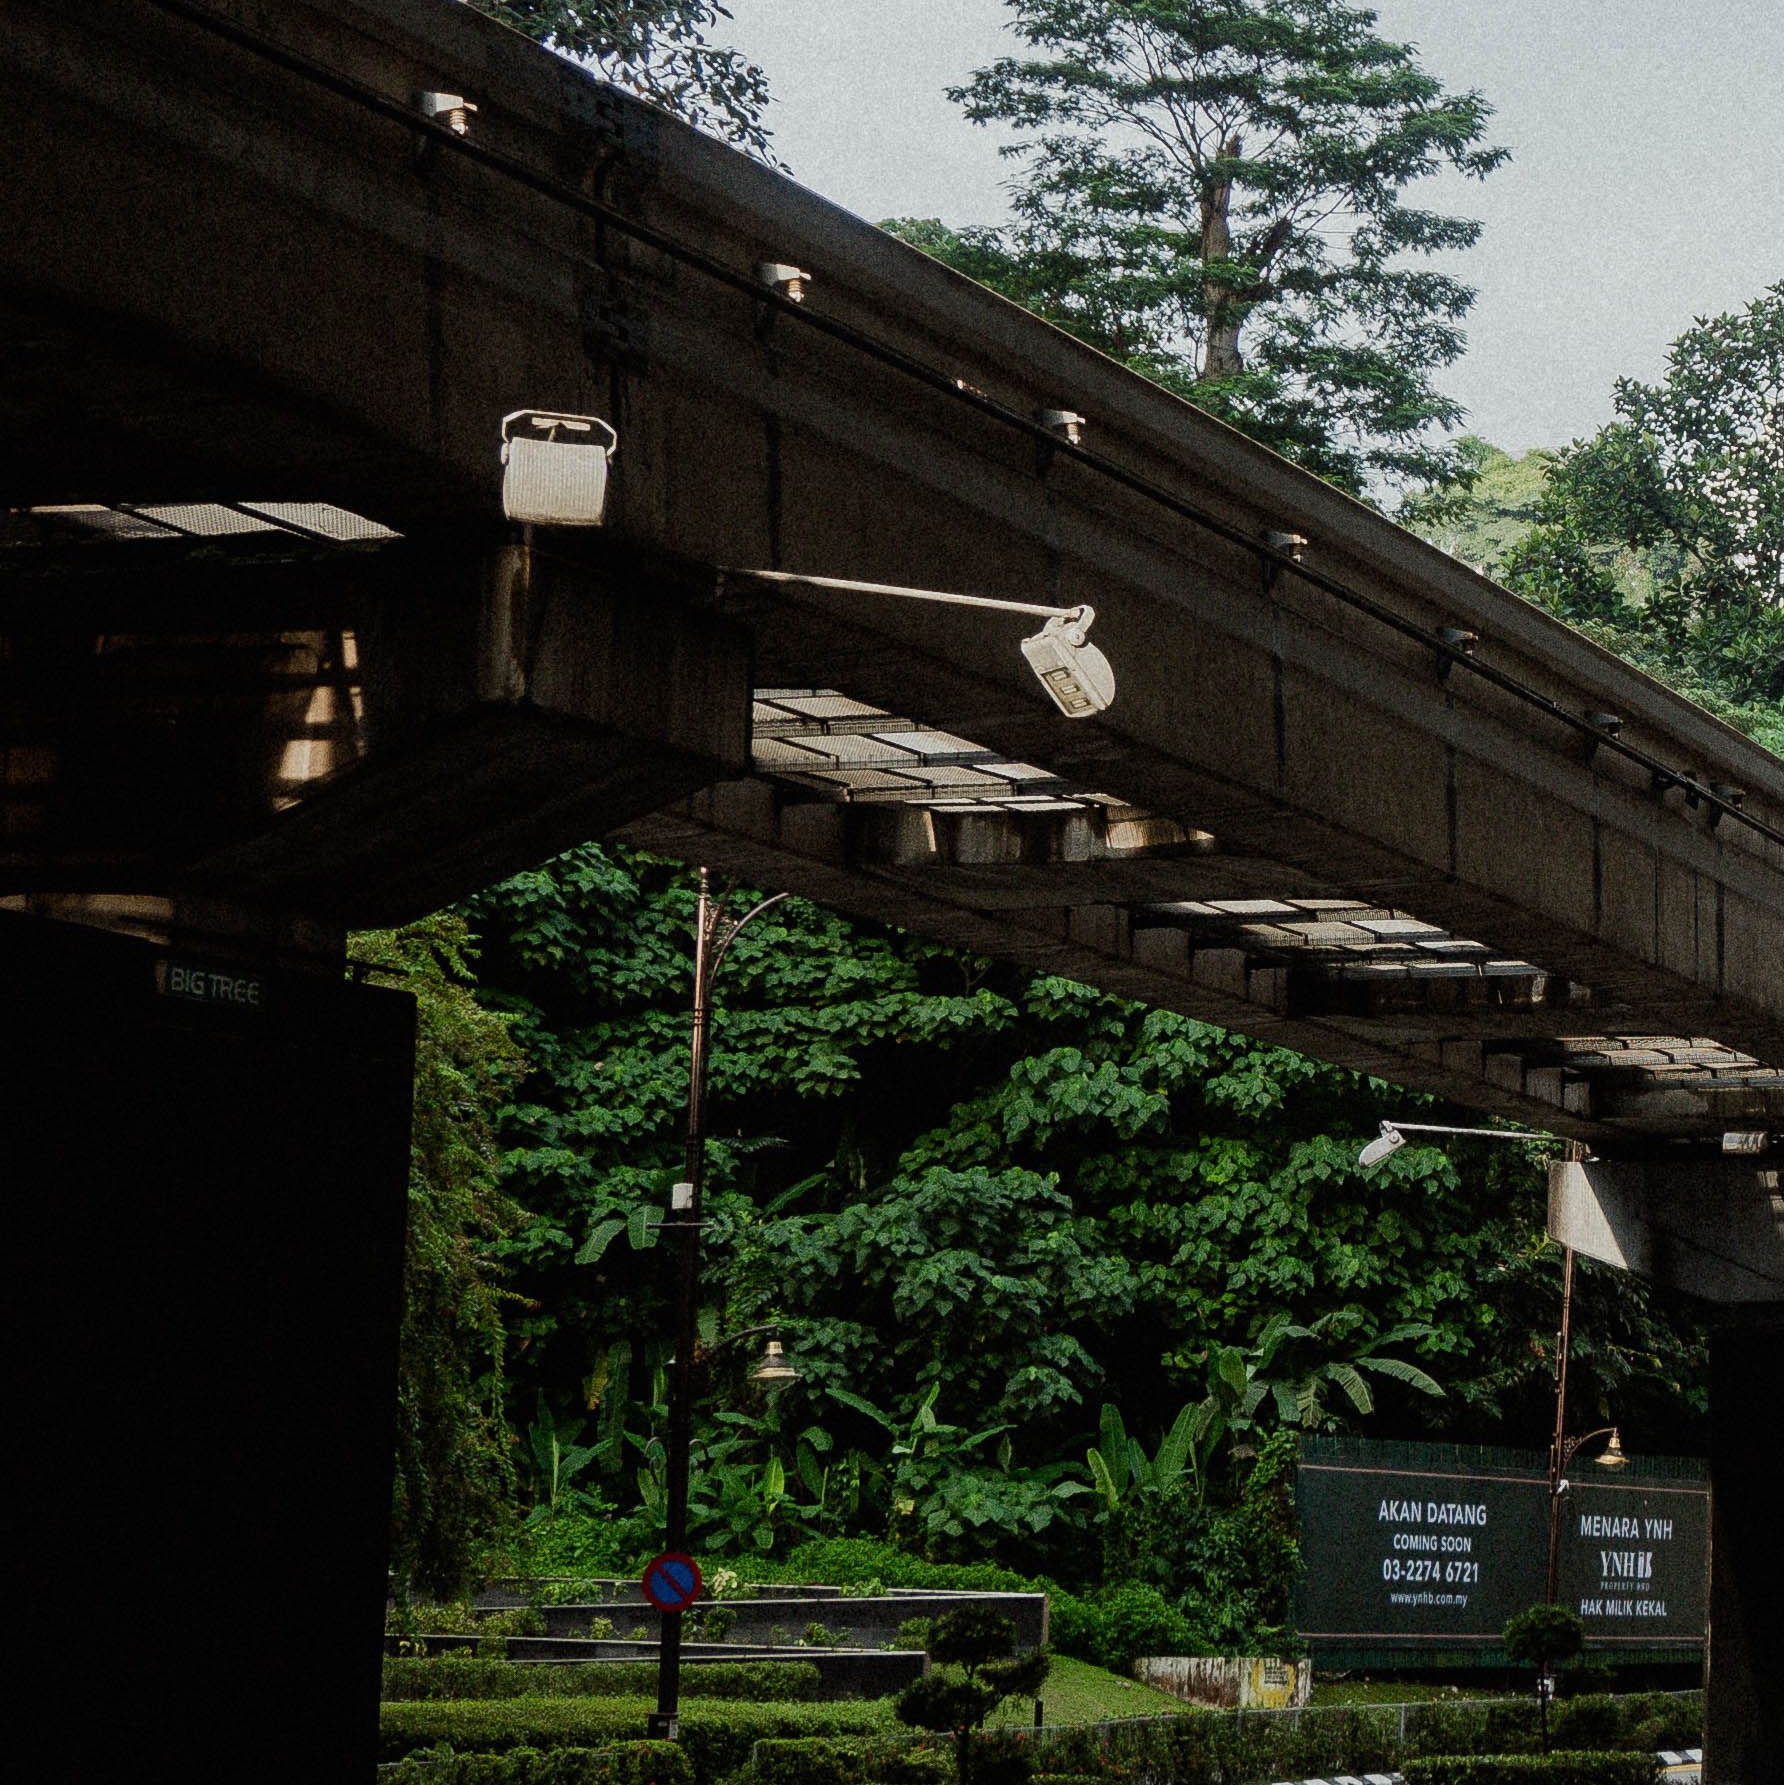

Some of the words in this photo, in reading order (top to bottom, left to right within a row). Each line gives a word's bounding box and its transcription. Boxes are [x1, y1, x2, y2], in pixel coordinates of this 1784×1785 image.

[170, 968, 206, 995] BIG
[208, 973, 261, 1006] TREE
[1378, 1499, 1422, 1523] AKAN
[1427, 1502, 1487, 1526] DATANG
[1580, 1514, 1640, 1539] MENARA
[1644, 1518, 1673, 1541] YNH
[1393, 1533, 1438, 1551] COMING
[1440, 1535, 1472, 1553] SOON
[1382, 1558, 1441, 1582] 03-2274
[1445, 1561, 1480, 1584] 6721
[1390, 1591, 1468, 1609] www.ynhb.com.my
[1580, 1598, 1603, 1616] HAK
[1605, 1599, 1634, 1617] MILIK
[1635, 1599, 1668, 1617] KEKAL
